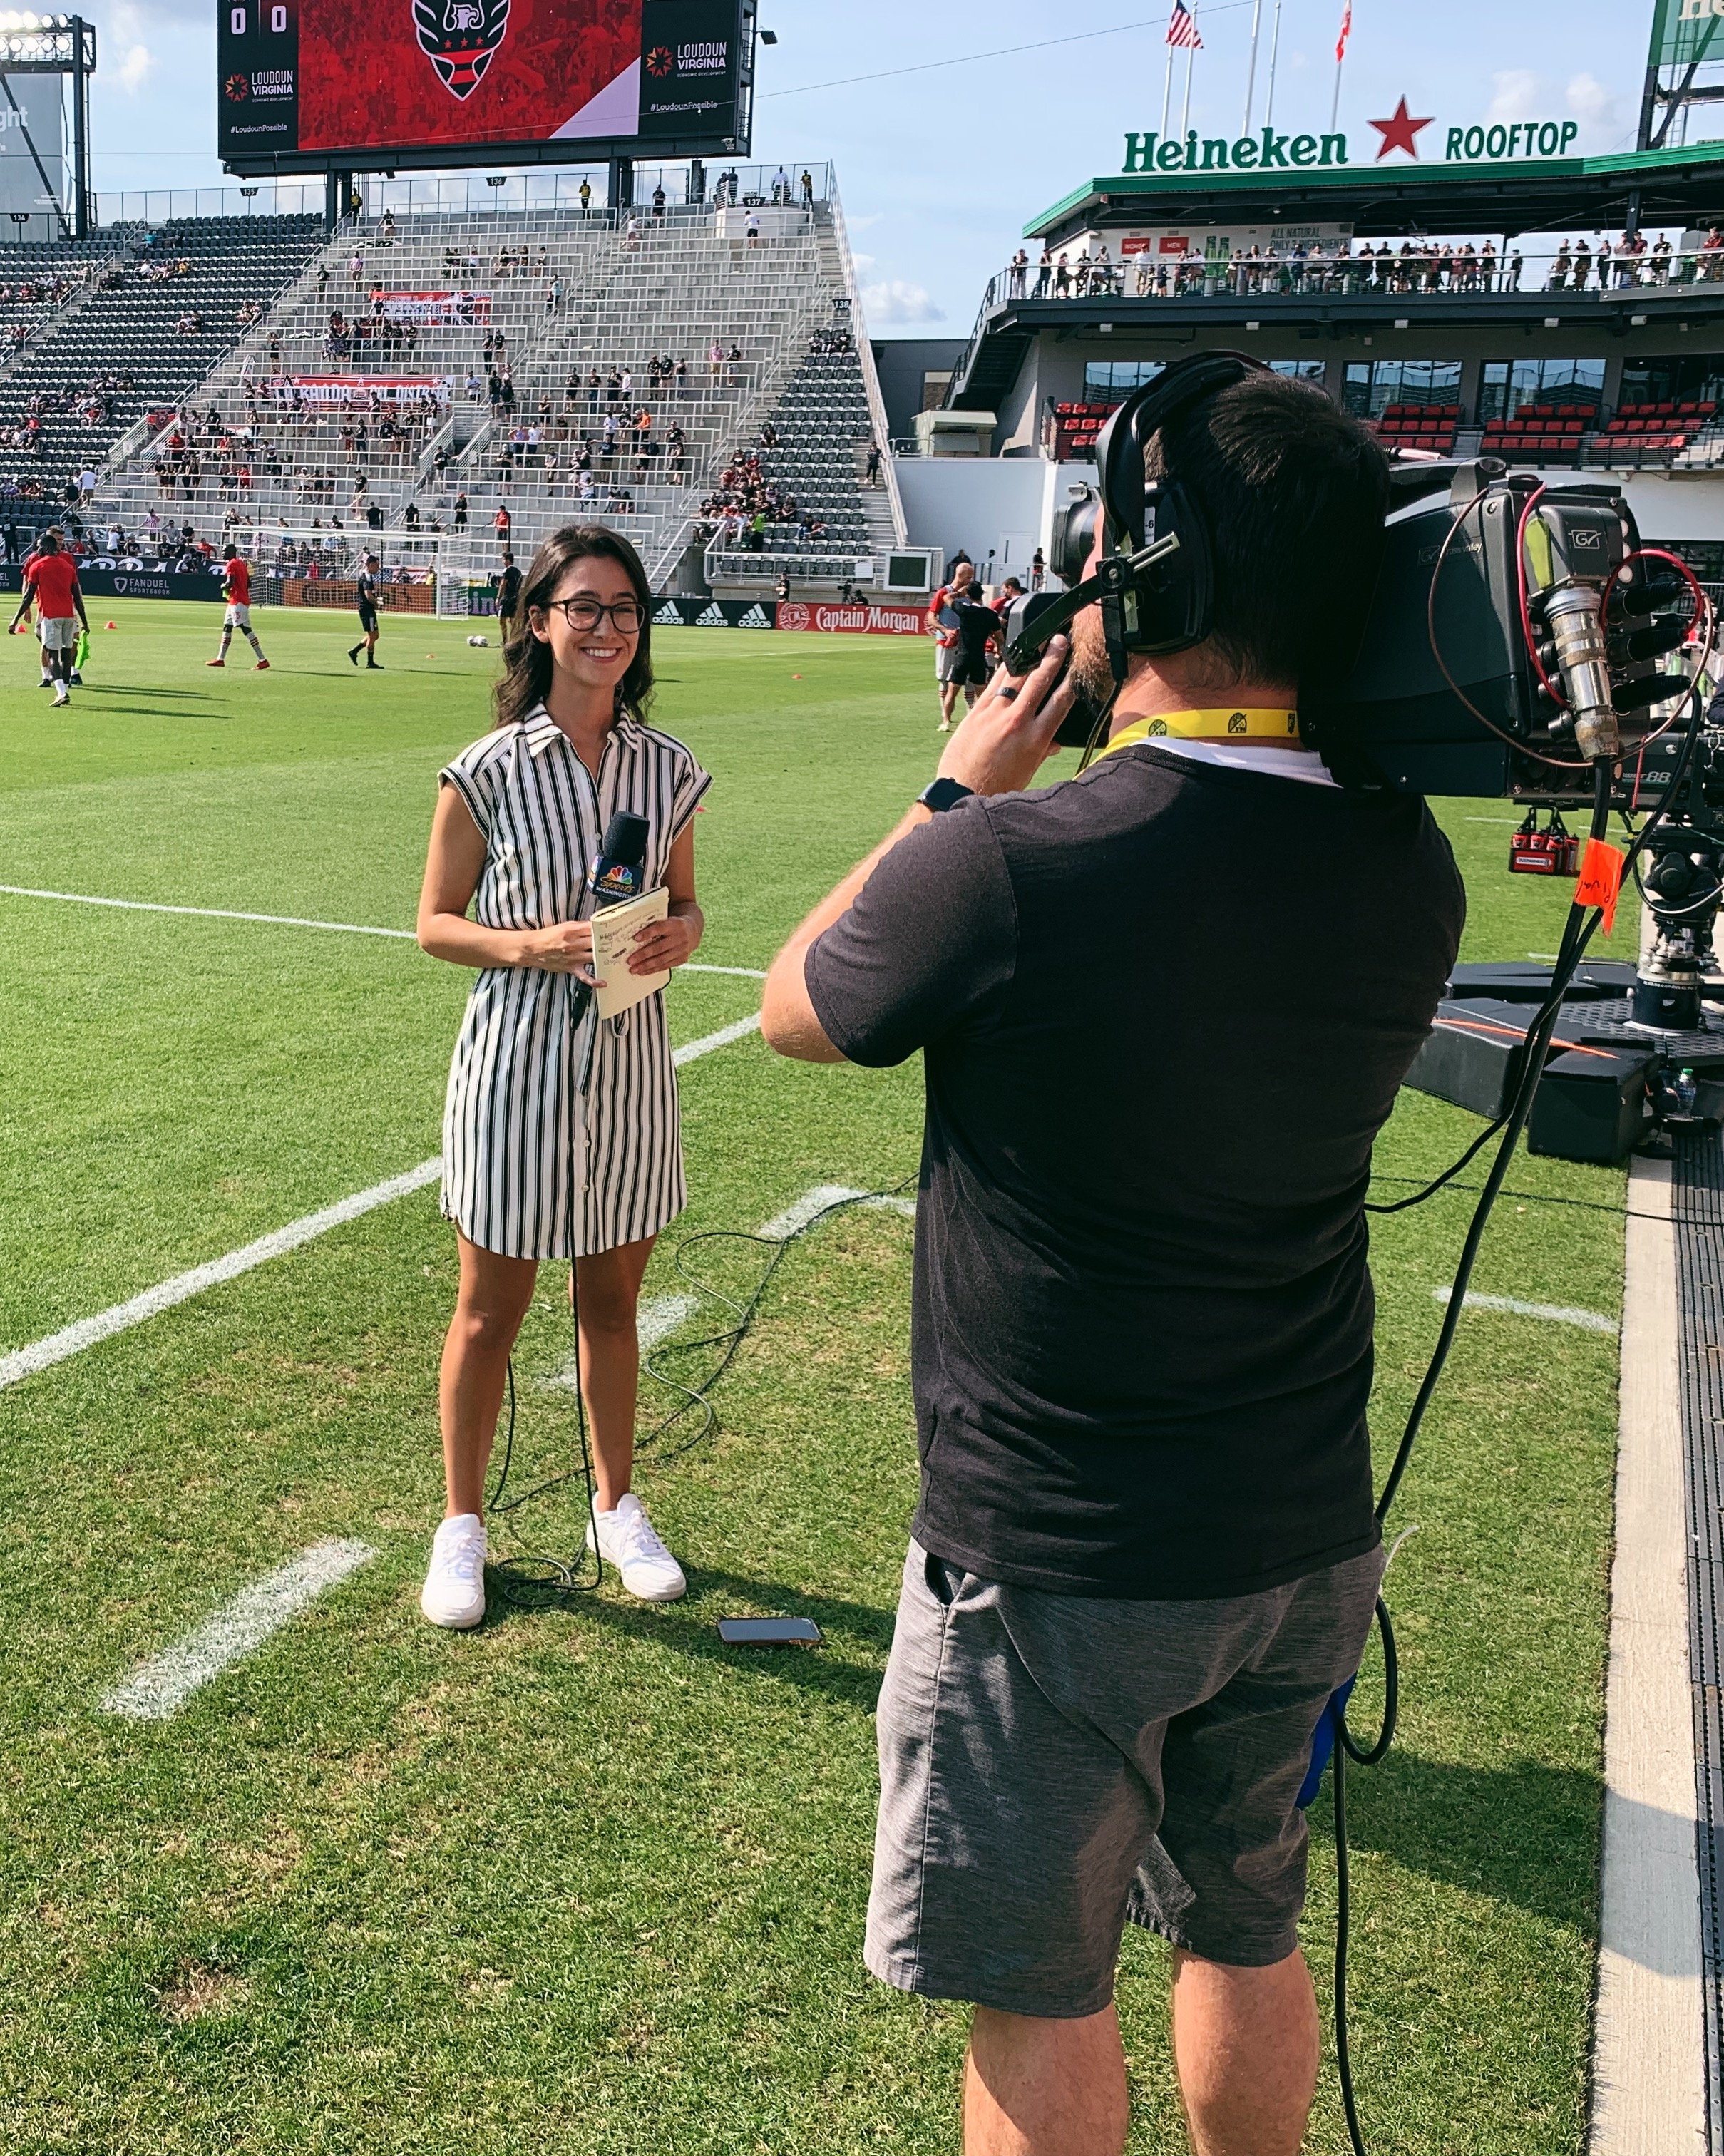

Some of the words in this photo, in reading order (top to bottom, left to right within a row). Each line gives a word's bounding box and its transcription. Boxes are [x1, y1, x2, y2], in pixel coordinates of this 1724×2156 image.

[231, 8, 246, 34] 0
[271, 5, 287, 32] 0
[677, 41, 727, 58] LOUDOUN
[677, 57, 726, 70] VIRGINIA
[252, 70, 293, 85] LOUDOUN
[252, 84, 293, 96] VIRGINIA
[650, 101, 718, 111] #LoudounPossible
[230, 123, 287, 134] #LoudounPossible
[1445, 120, 1578, 160] ROOFTOP
[1122, 126, 1348, 173] Heineken
[1271, 227, 1286, 238] ALL
[1286, 227, 1320, 237] NATURAL
[835, 300, 849, 309] 138
[129, 578, 170, 588] FANDUEL
[652, 616, 684, 625] adidas
[696, 617, 729, 627] adidas
[738, 619, 771, 629] adidas
[816, 606, 863, 632] Captain
[861, 606, 918, 634] Morgan
